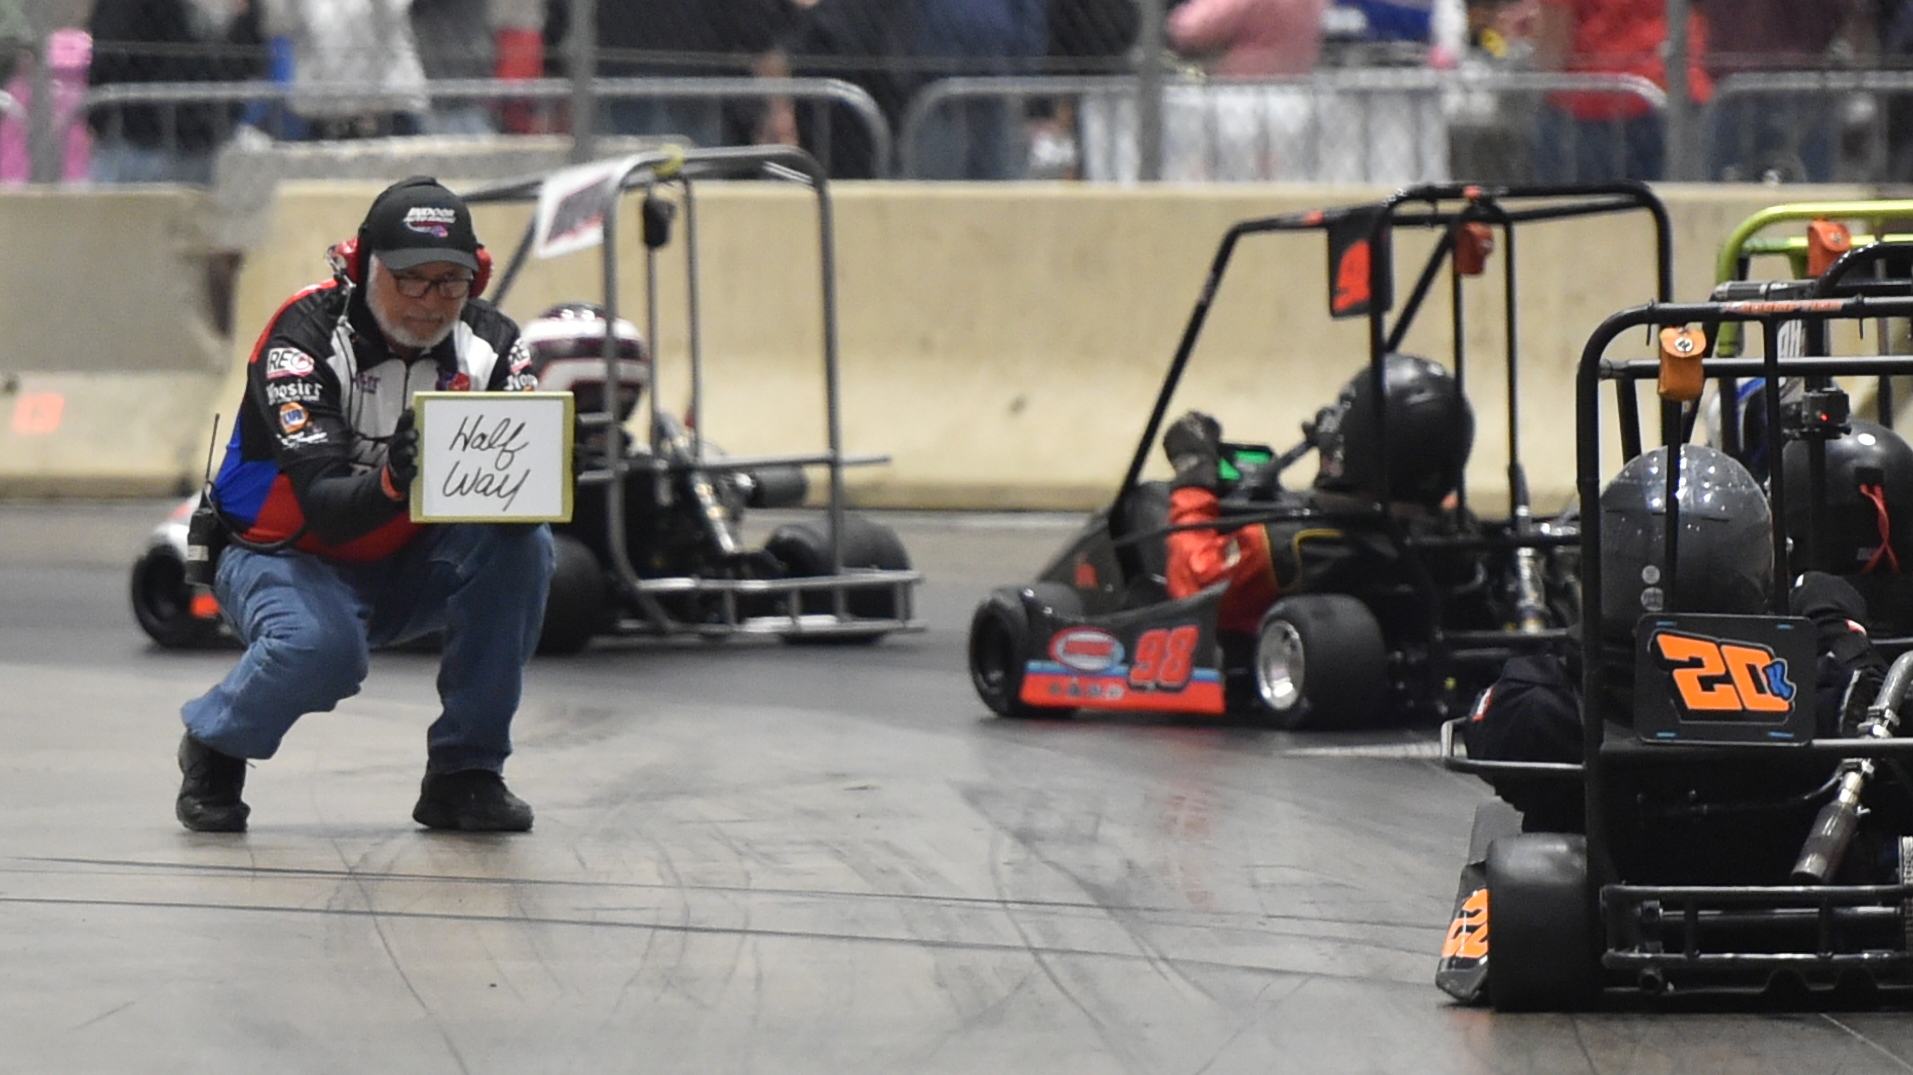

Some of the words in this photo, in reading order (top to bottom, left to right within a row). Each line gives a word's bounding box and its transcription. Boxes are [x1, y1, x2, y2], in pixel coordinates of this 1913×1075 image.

[449, 414, 529, 471] Half
[442, 460, 530, 512] Way
[1129, 625, 1199, 691] 98
